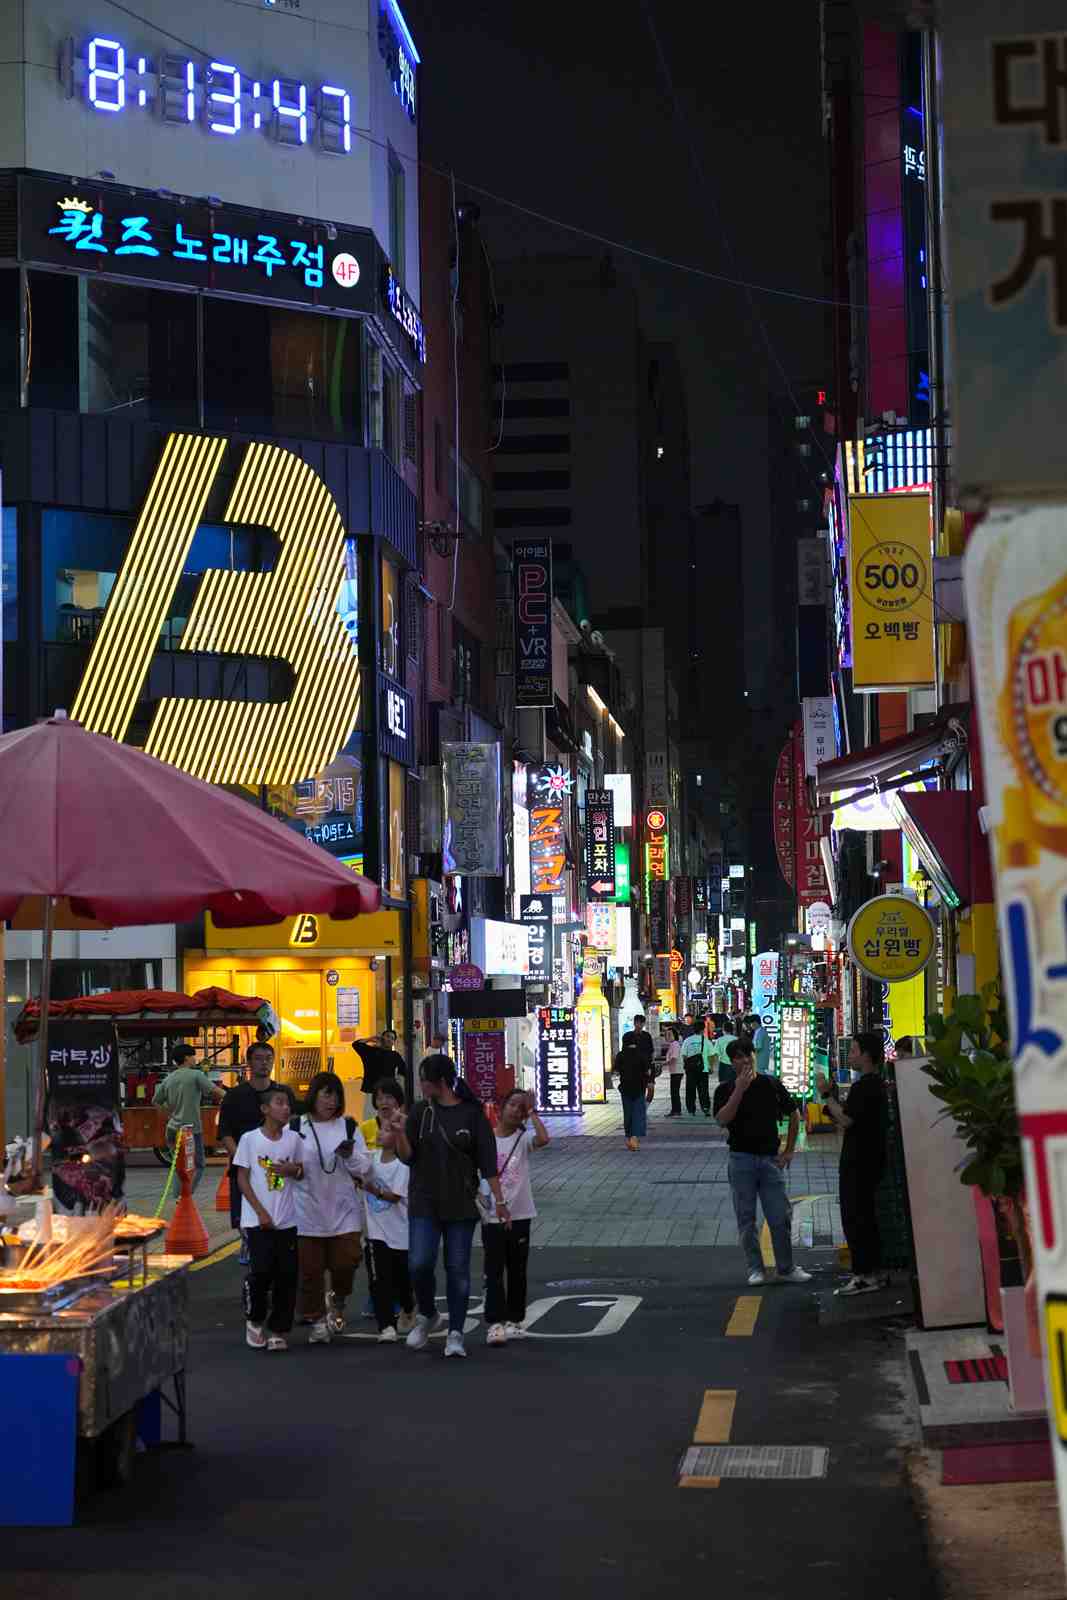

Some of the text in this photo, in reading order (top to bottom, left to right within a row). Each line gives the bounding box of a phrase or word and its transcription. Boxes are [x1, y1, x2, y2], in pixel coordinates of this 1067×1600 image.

[88, 37, 351, 152] 8:13:47
[48, 208, 358, 288] 퀸즈 노래주점 4F
[864, 563, 919, 590] 500
[864, 621, 920, 642] 오백빵
[519, 637, 547, 656] VR
[527, 923, 546, 965] 안경
[863, 938, 921, 958] 십원빵
[541, 1028, 573, 1041] 소주호프
[546, 1041, 570, 1106] 노래주점
